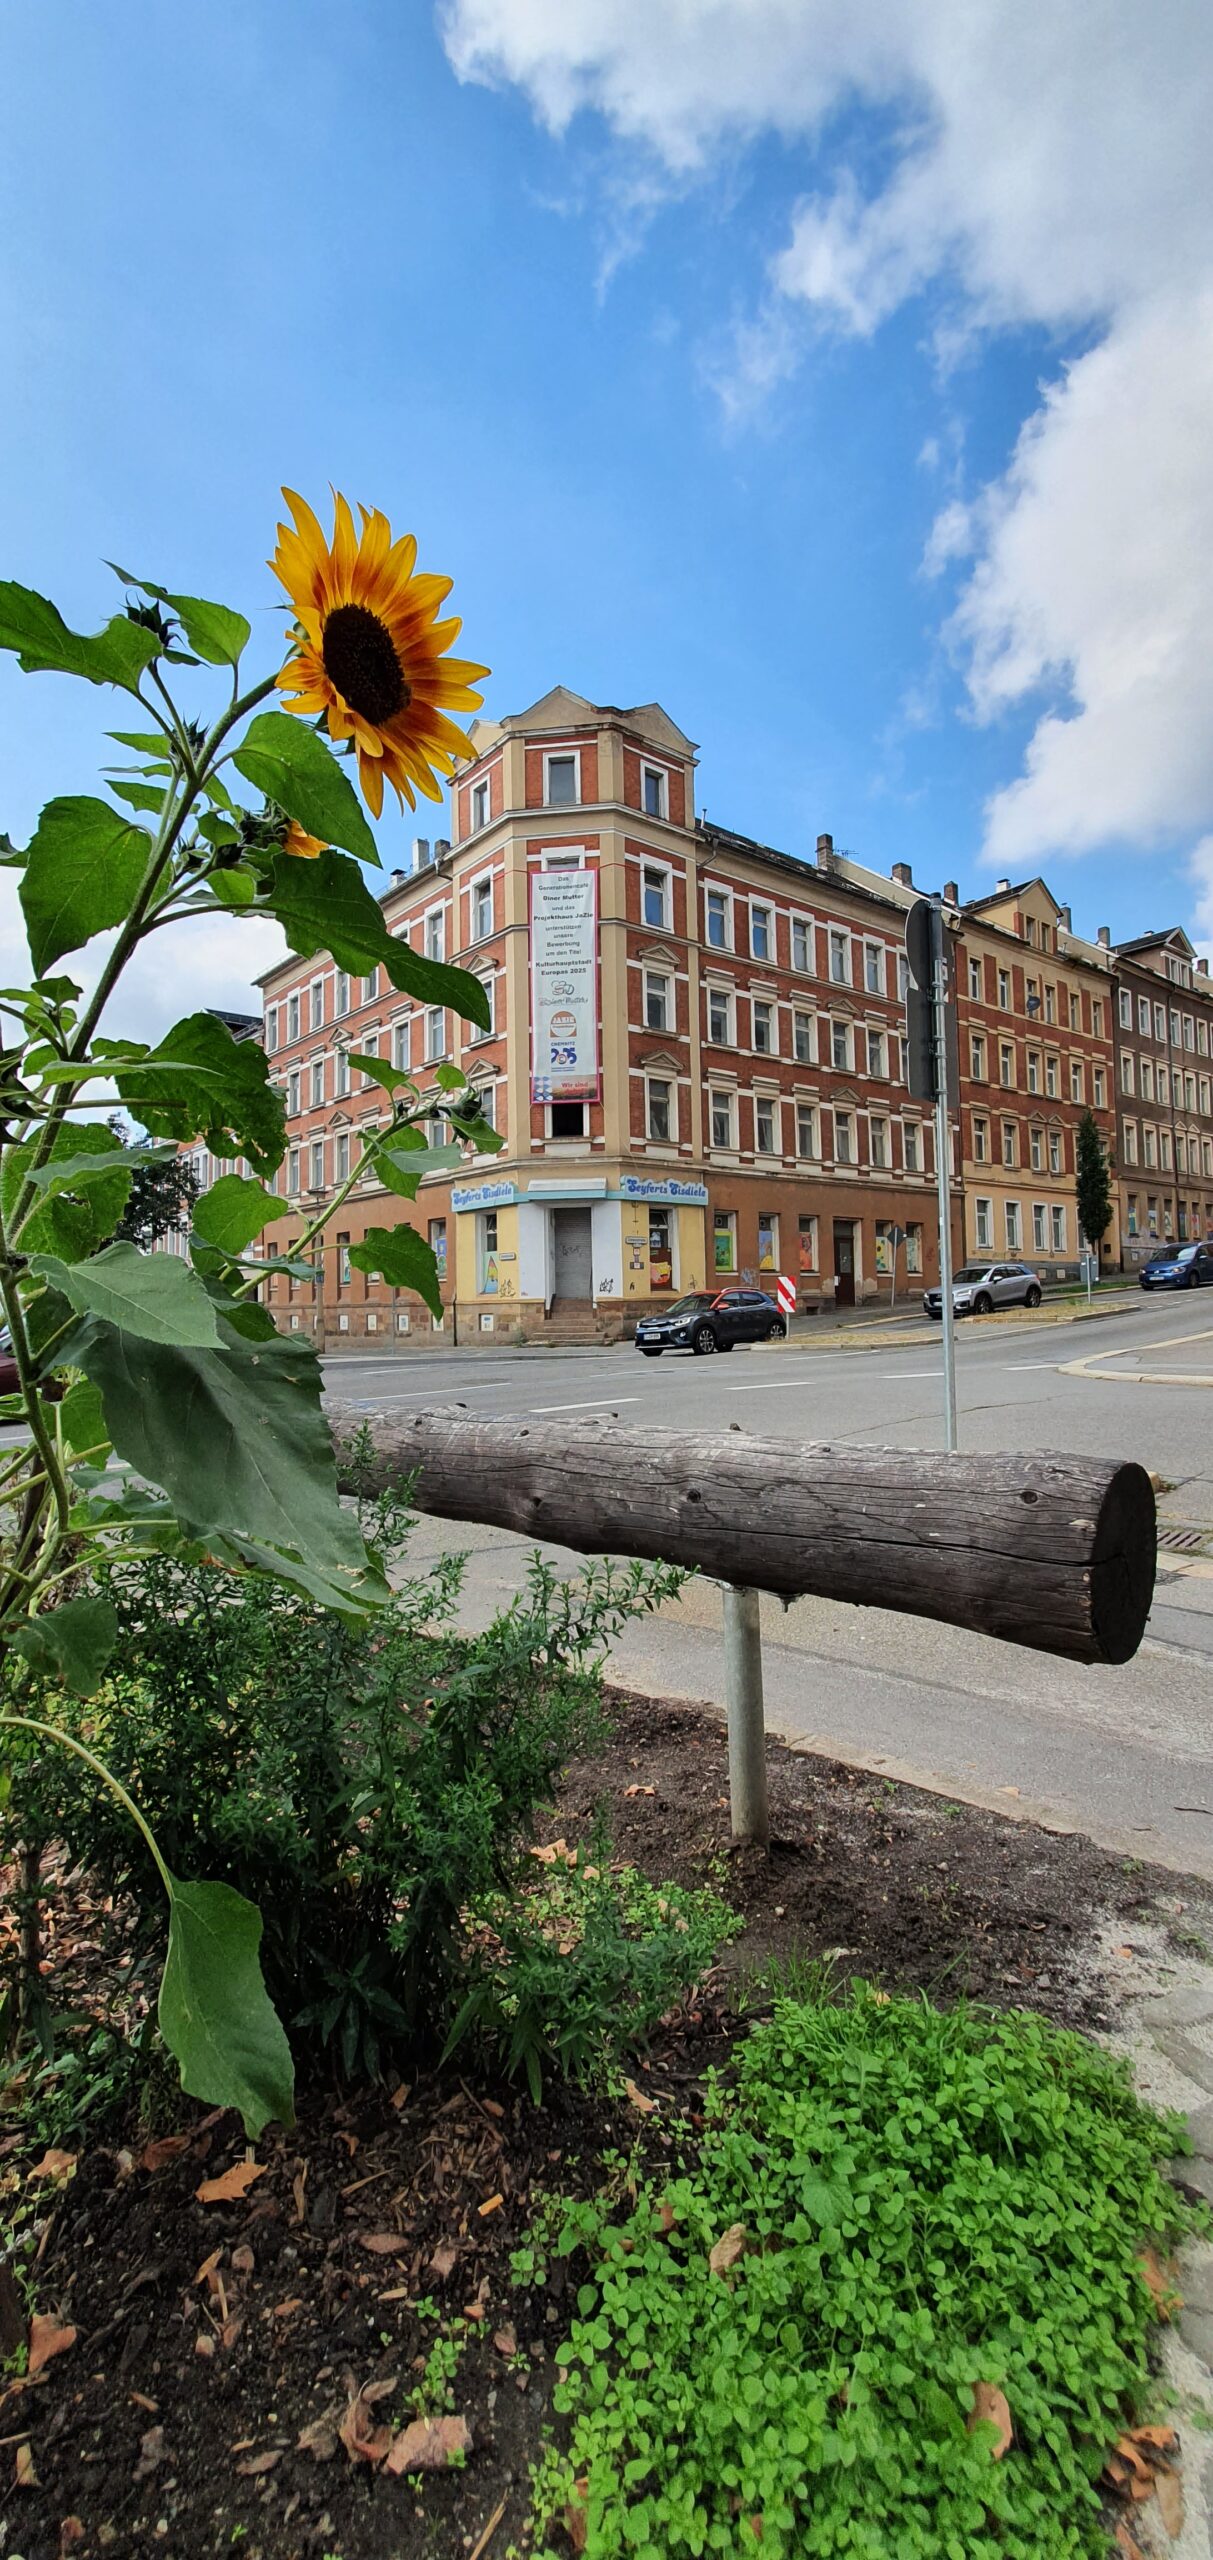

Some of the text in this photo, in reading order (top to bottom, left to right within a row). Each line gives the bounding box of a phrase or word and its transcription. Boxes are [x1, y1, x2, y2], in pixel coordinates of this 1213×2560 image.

[453, 1184, 512, 1205] Seyferts Eisdiele
[626, 1178, 706, 1197] Seyferts Eisdiele
